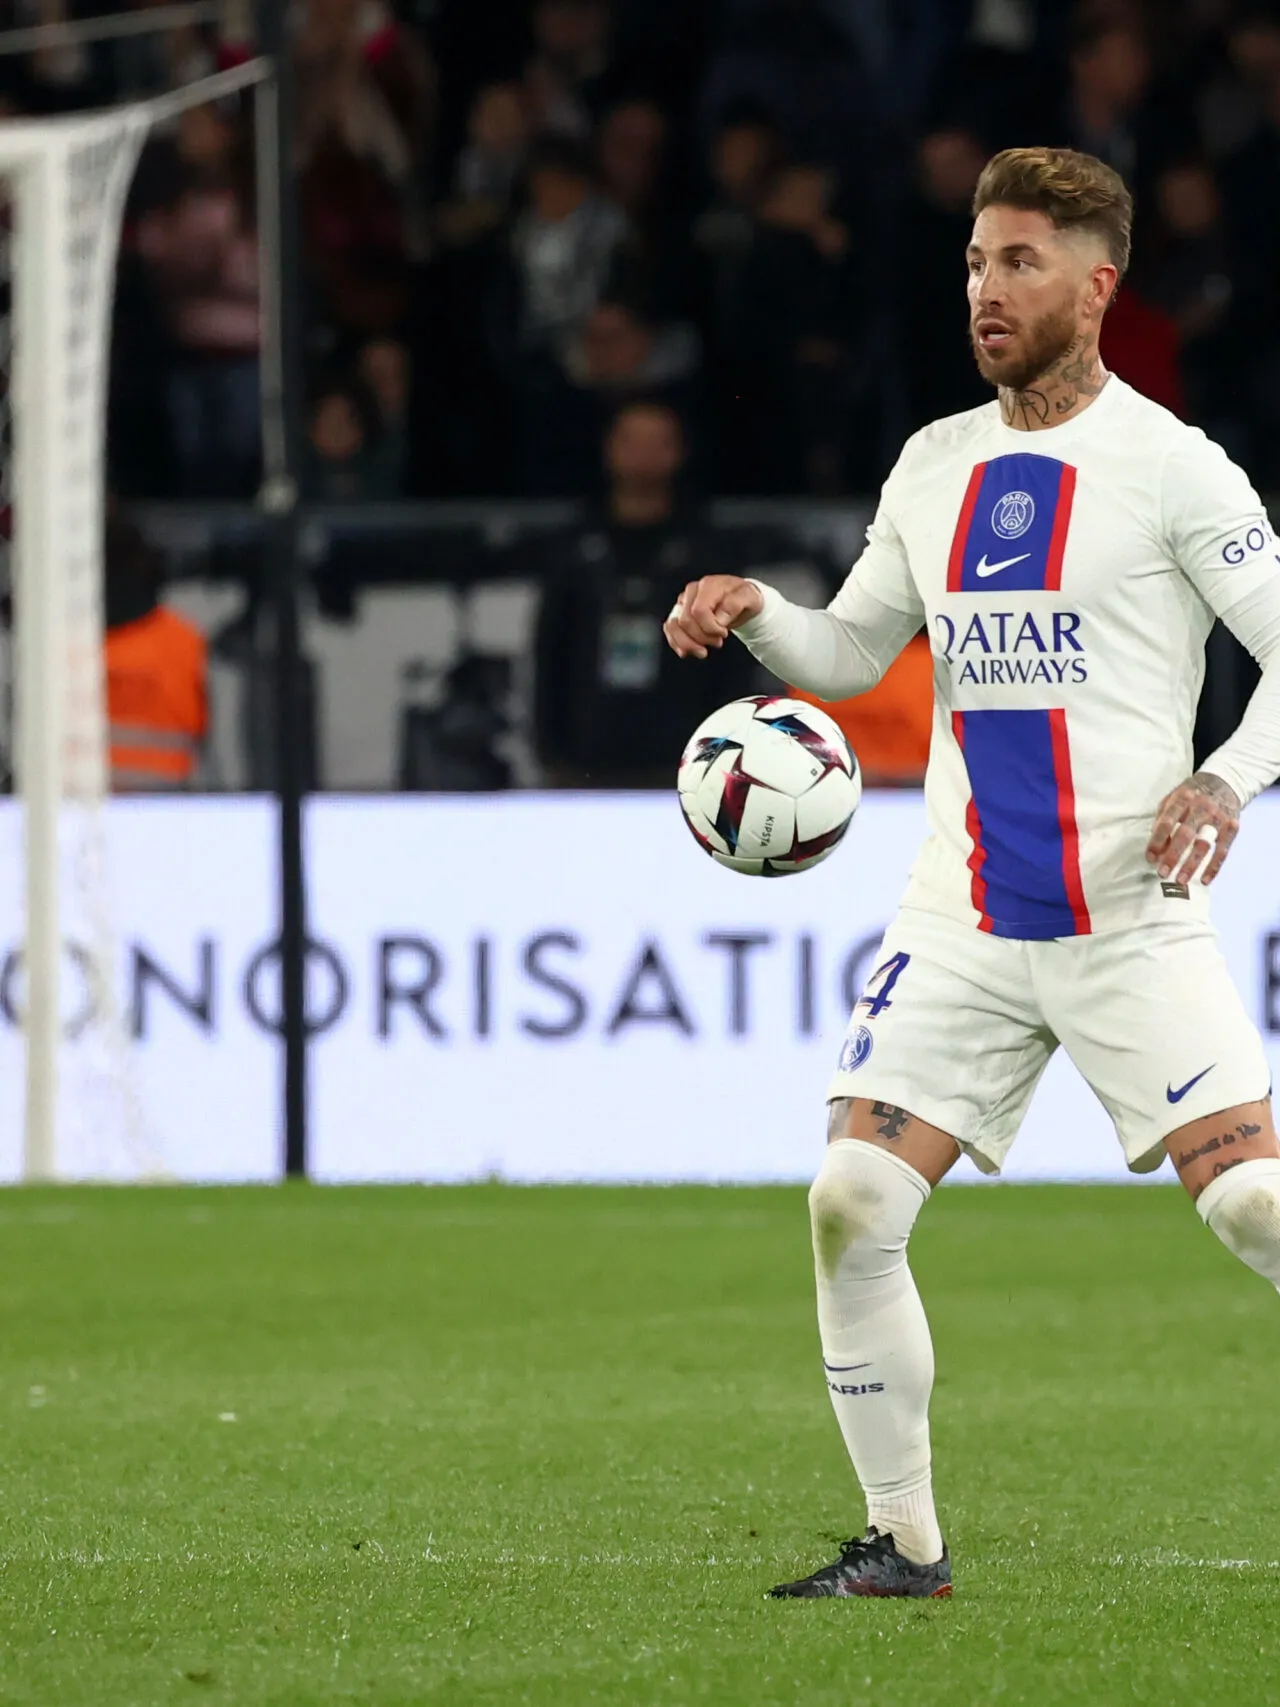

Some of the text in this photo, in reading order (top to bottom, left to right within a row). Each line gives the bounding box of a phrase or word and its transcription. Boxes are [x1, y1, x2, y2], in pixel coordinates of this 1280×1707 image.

[1002, 493, 1031, 506] PARIS
[958, 657, 1088, 685] AIRWAYS
[759, 815, 775, 847] KIPSTA
[858, 951, 911, 1019] 4
[825, 1381, 885, 1395] ARIS
